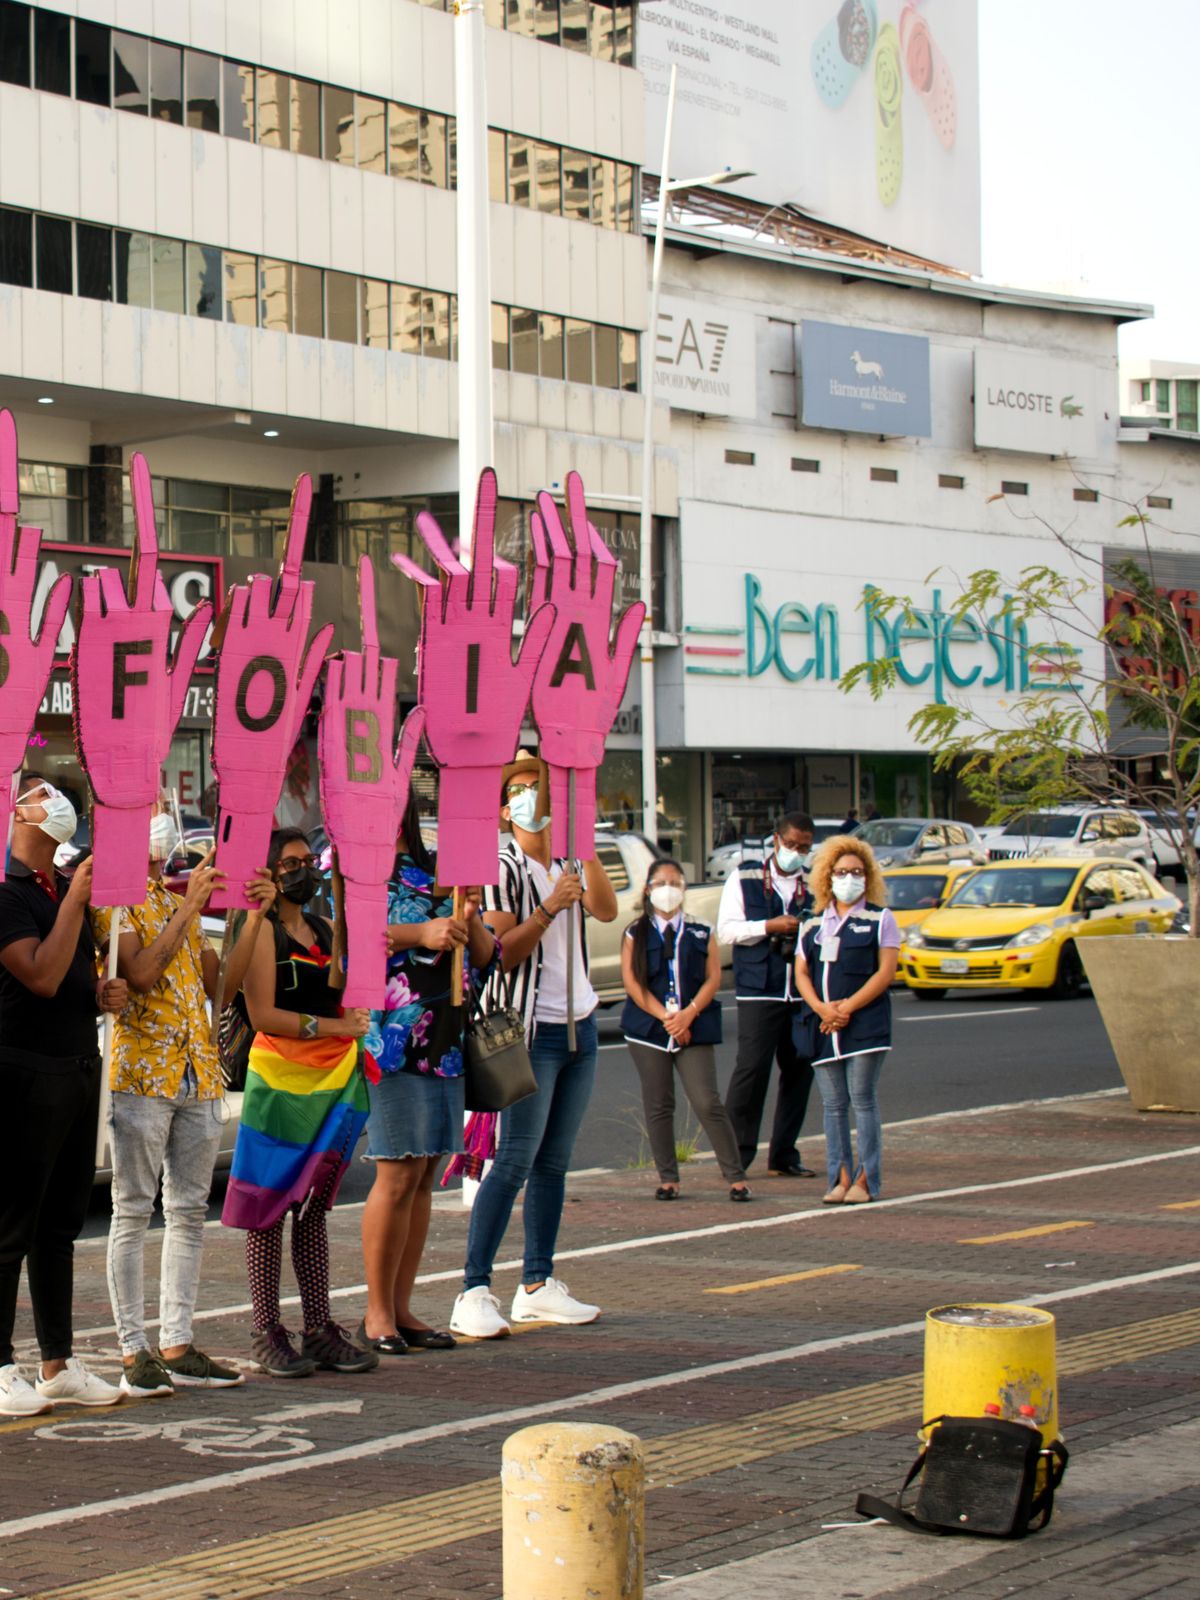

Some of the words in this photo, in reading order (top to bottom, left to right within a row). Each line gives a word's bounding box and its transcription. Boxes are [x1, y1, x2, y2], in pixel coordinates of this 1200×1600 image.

[656, 312, 729, 373] EA7
[987, 387, 1053, 414] LACOSTE
[548, 622, 596, 691] A
[744, 572, 840, 683] Ben
[111, 639, 153, 720] F
[235, 655, 287, 732] O
[465, 643, 481, 714] I
[345, 708, 383, 784] B
